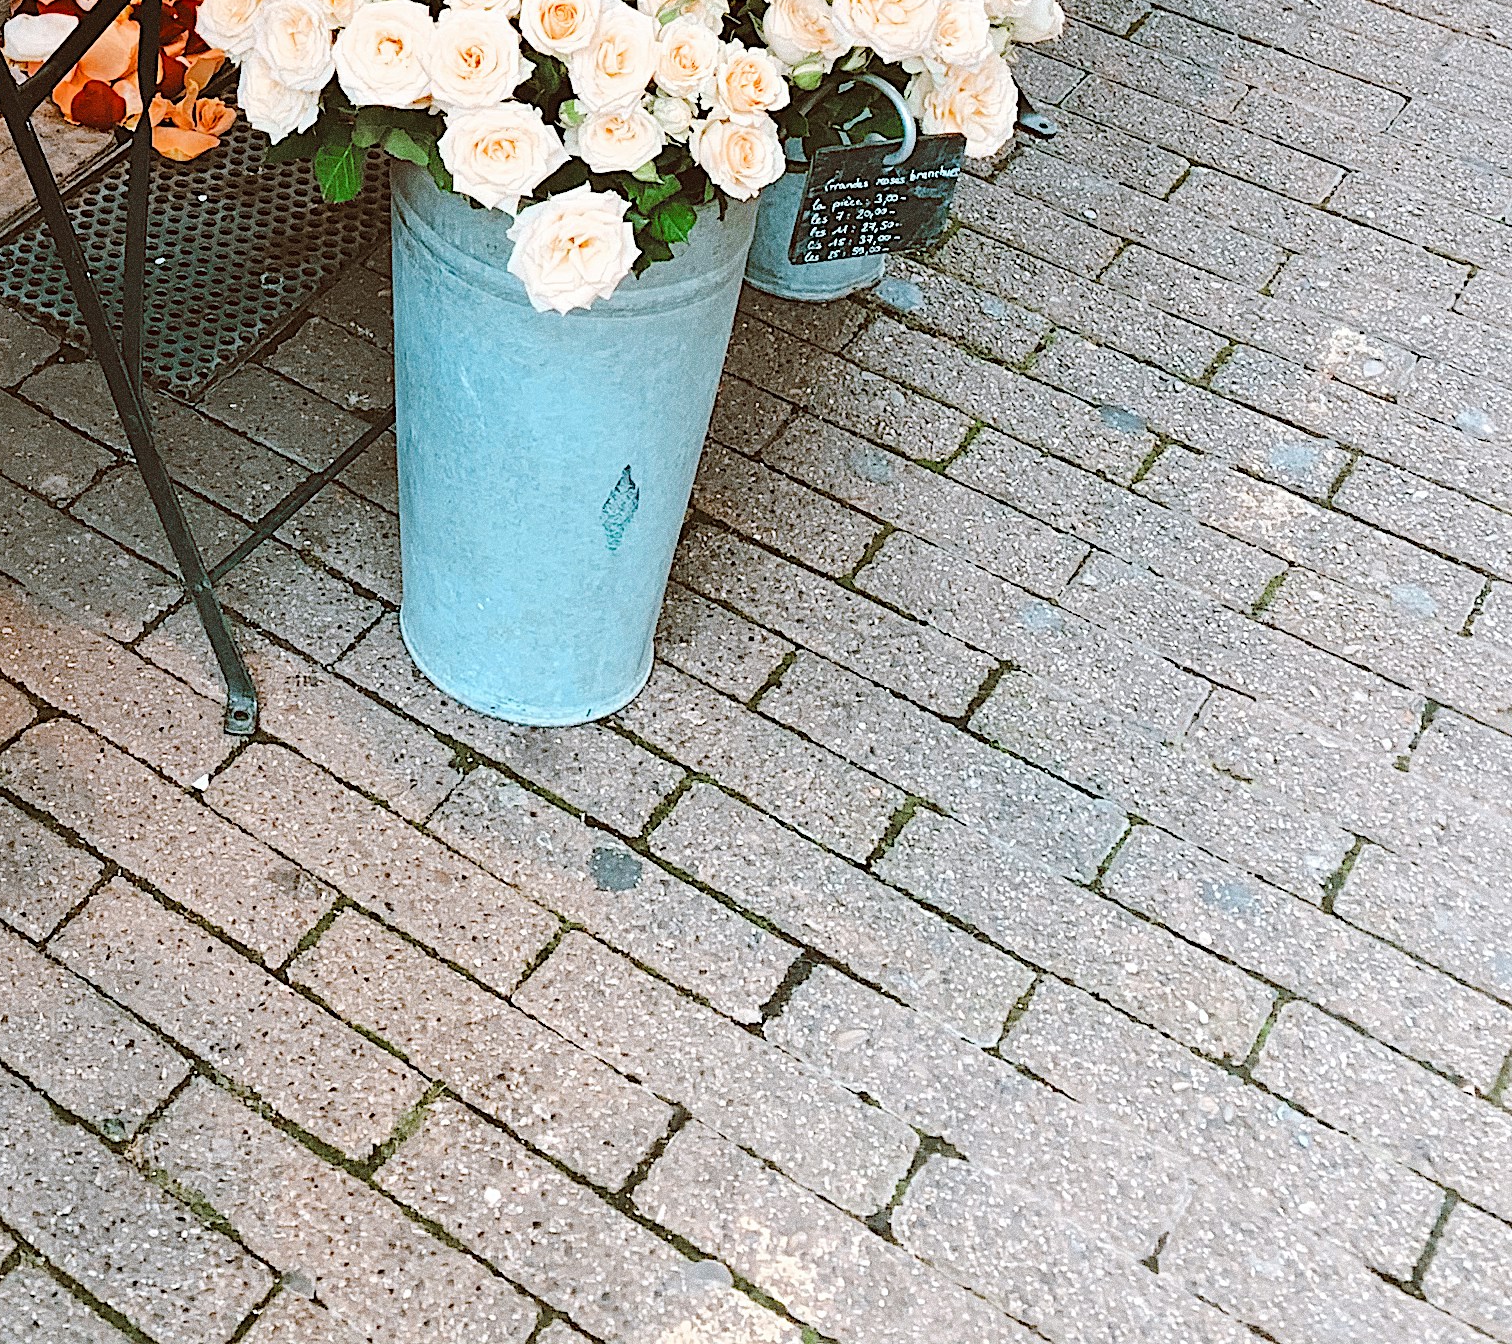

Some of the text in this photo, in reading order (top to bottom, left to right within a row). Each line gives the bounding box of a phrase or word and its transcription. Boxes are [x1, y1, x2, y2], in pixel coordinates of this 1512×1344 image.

[824, 177, 869, 193] Grandes
[875, 176, 906, 187] roses
[812, 198, 826, 211] la
[810, 212, 828, 225] les
[809, 226, 827, 238] les
[807, 239, 823, 250] les
[804, 251, 820, 262] les
